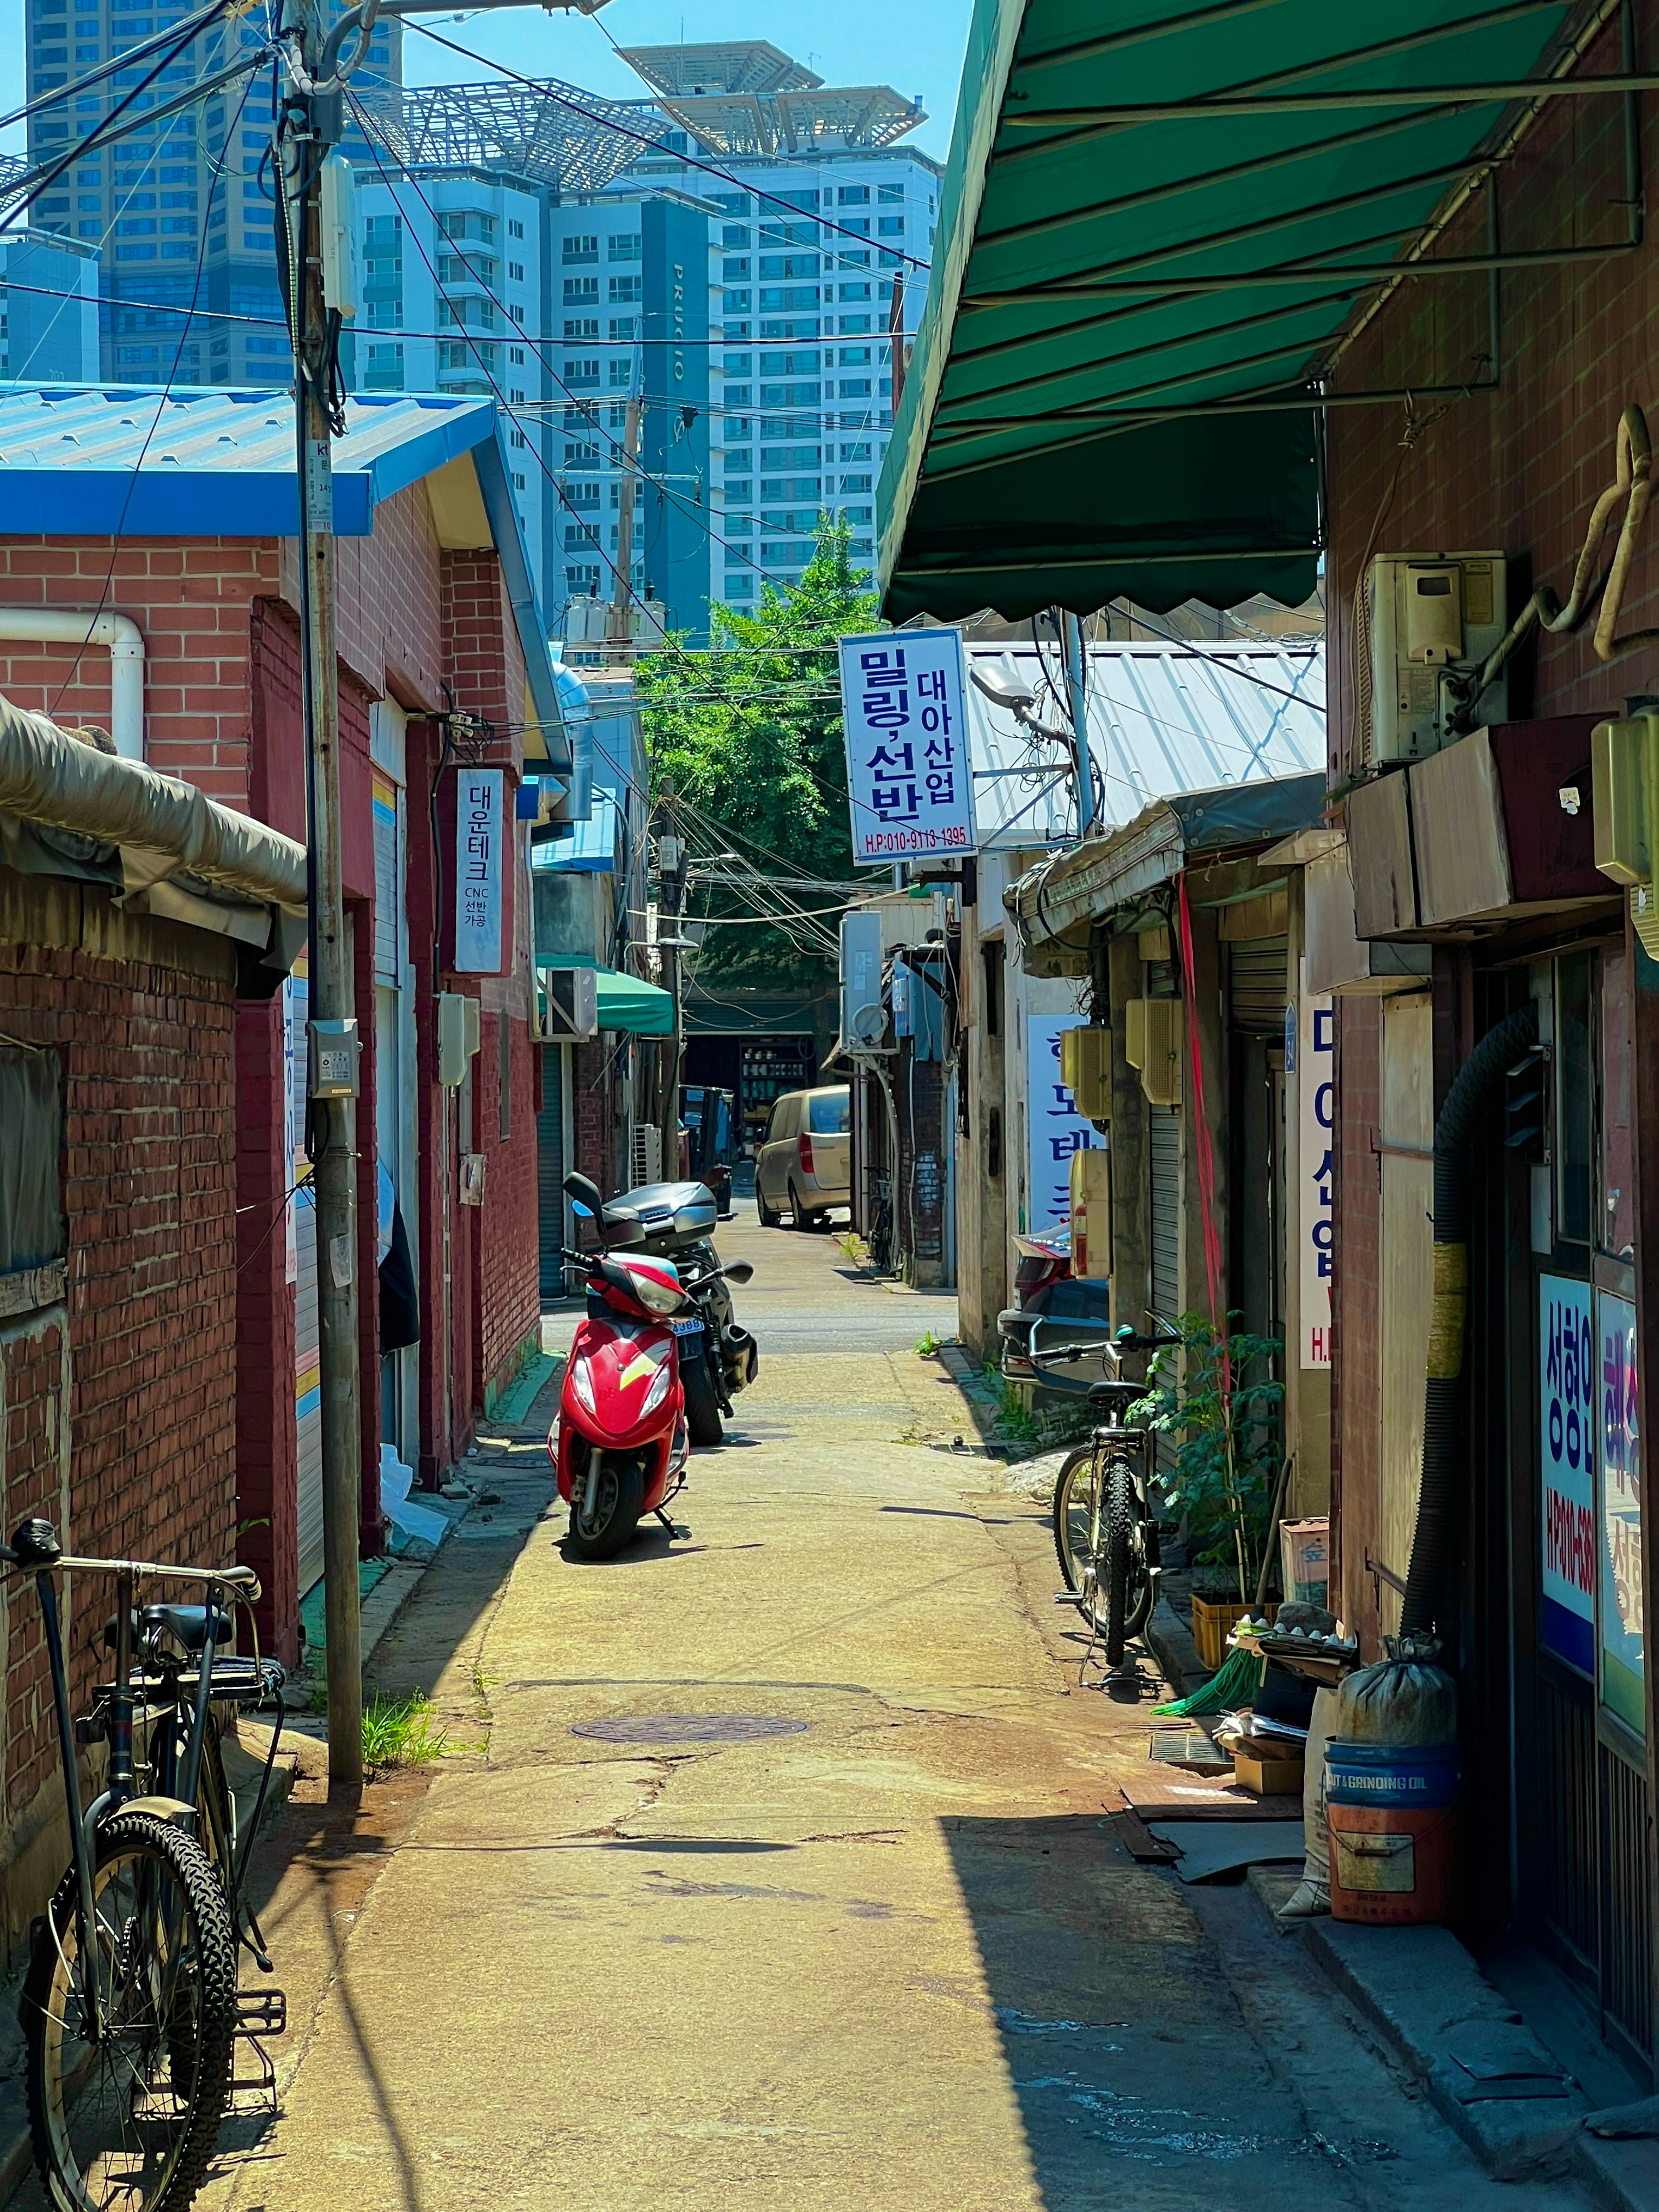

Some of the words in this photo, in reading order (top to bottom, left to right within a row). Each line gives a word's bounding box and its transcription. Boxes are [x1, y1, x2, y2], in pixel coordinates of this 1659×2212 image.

[861, 649, 923, 822] 밀링,선반
[917, 669, 954, 805] 대아산업
[465, 786, 491, 881] 대운테크
[465, 888, 488, 898] CNC
[465, 902, 487, 913] 선반
[465, 915, 487, 927] 가공
[673, 1318, 699, 1332] 4388
[1348, 1775, 1406, 1790] GRINDING
[1408, 1776, 1427, 1790] OIL
